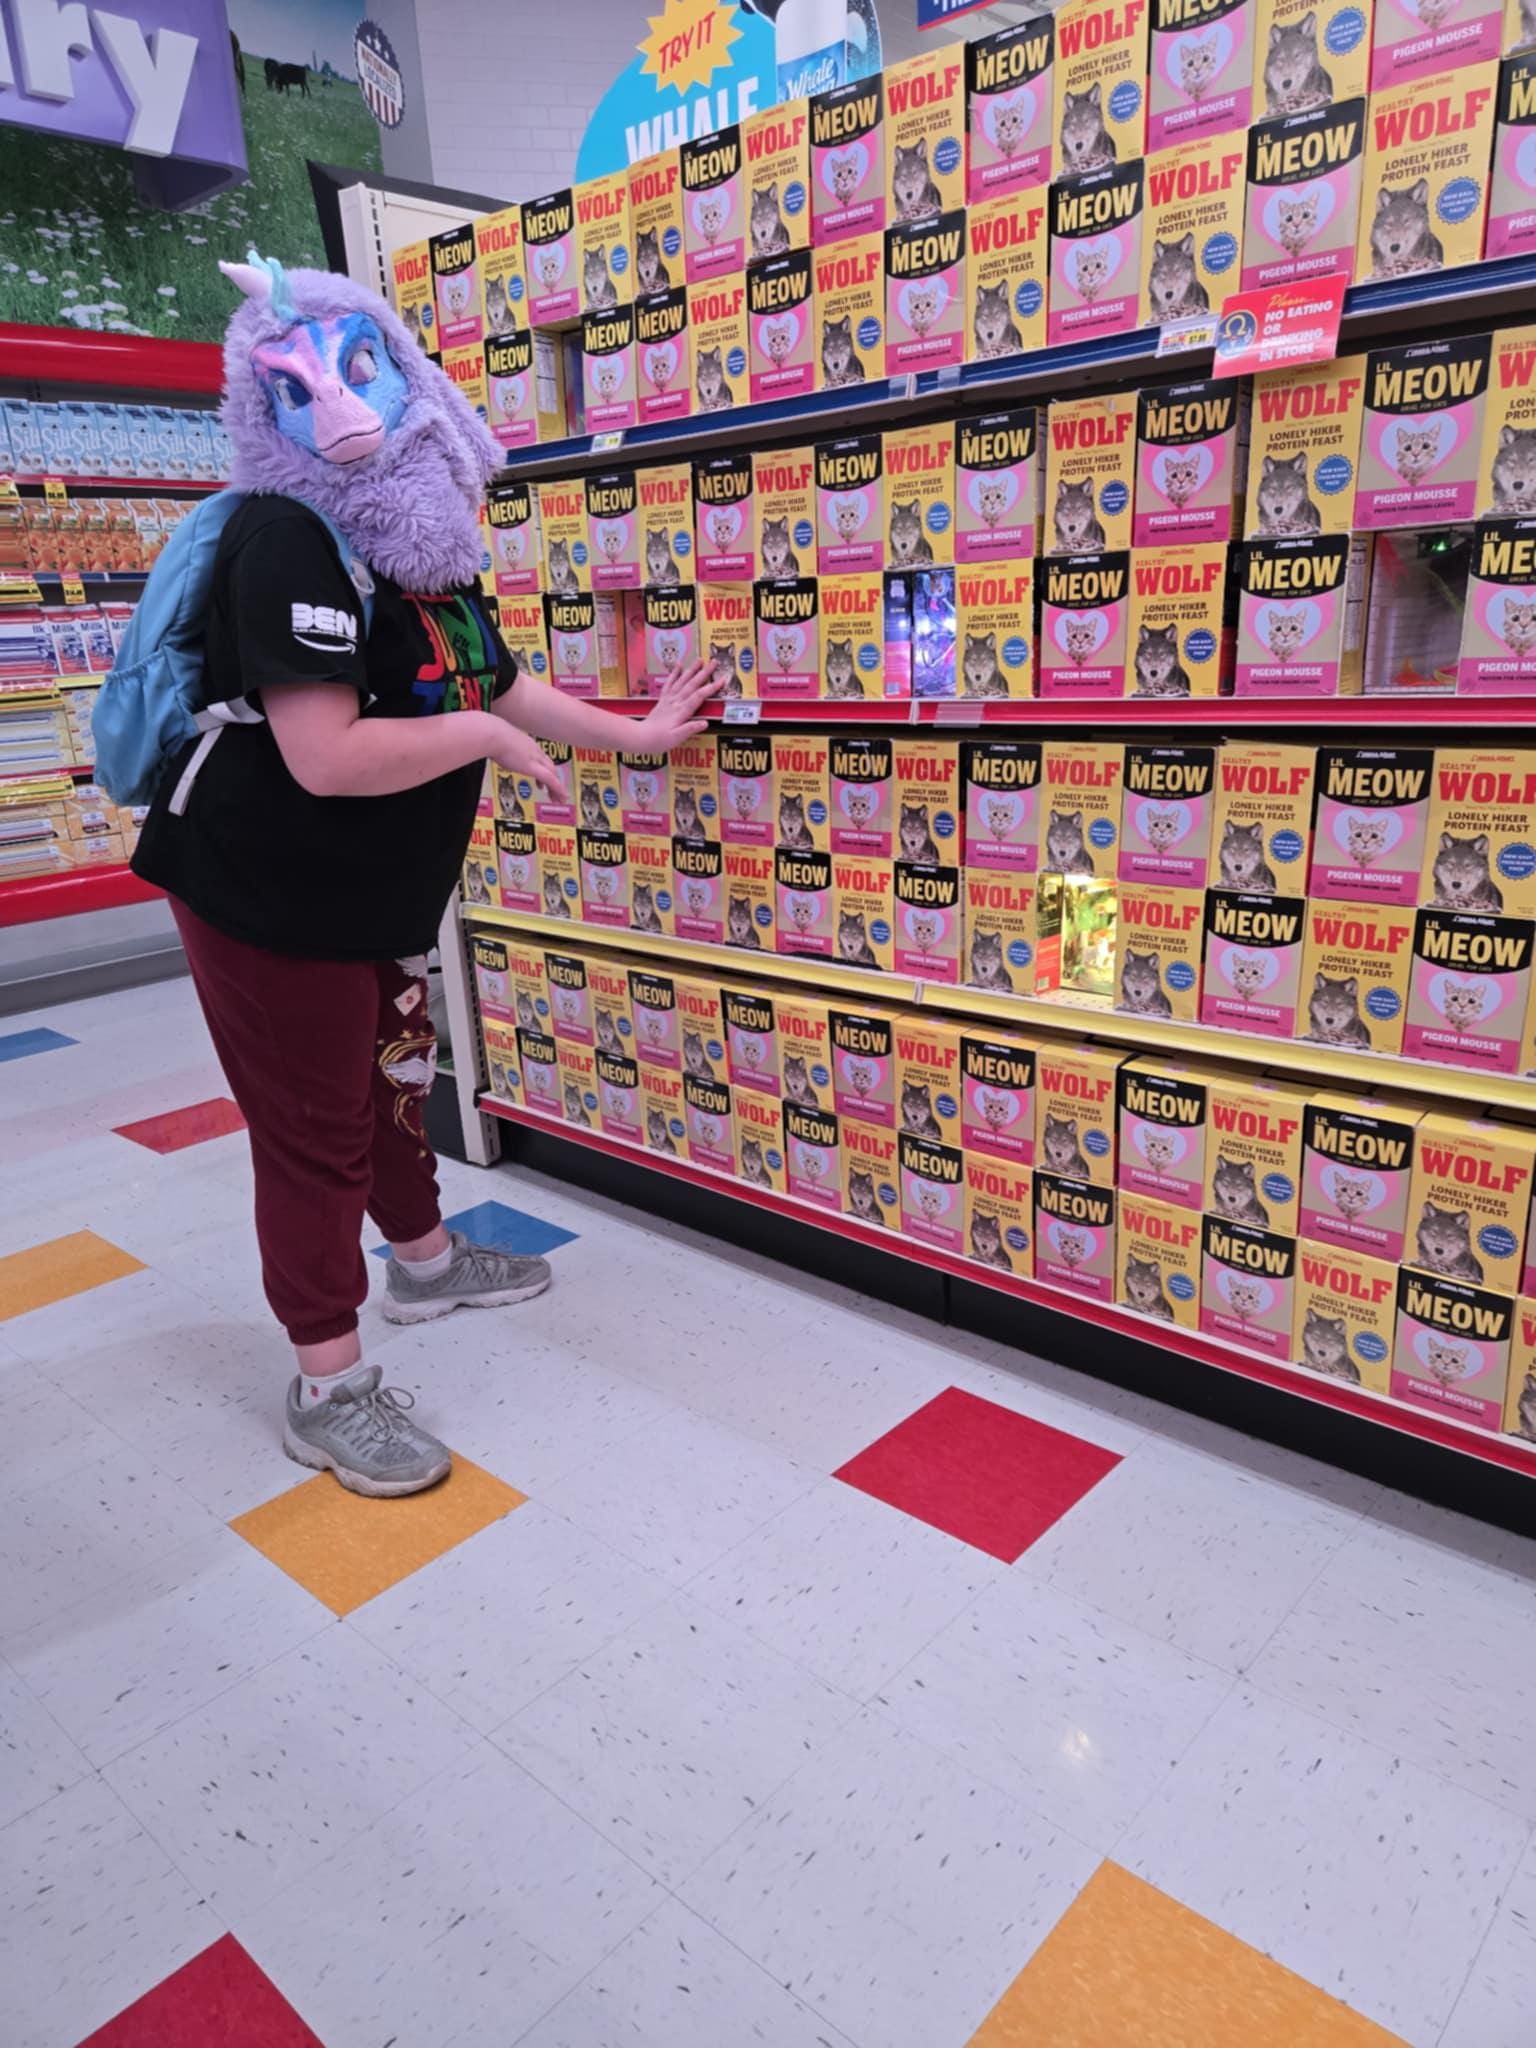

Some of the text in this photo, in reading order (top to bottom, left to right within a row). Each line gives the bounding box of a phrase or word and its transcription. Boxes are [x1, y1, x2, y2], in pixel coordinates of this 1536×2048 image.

[658, 10, 716, 74] TRY IT
[1060, 0, 1144, 59] WOLF
[1393, 22, 1483, 60] PIGEON MOUSSE
[976, 35, 1048, 89] MEOW
[1066, 60, 1132, 88] PROTEIN FEAST
[1068, 50, 1130, 77] LONELY HIKER
[888, 66, 961, 116] WOLF
[814, 95, 877, 143] MEOW
[1375, 87, 1491, 151] WOLF
[747, 115, 806, 162] WOLF
[1256, 123, 1356, 181] MEOW
[1258, 134, 1271, 145] LIL
[685, 145, 737, 187] MEOW
[1381, 155, 1471, 183] PROTEIN FEAST
[1385, 143, 1468, 171] LONELY HIKER
[629, 166, 678, 206] WOLF
[1149, 153, 1242, 206] WOLF
[577, 187, 626, 224] WOLF
[1058, 183, 1138, 234] MEOW
[526, 205, 570, 241] MEOW
[971, 208, 1044, 255] WOLF
[478, 222, 519, 256] WOLF
[892, 230, 960, 274] MEOW
[394, 254, 428, 285] WOLF
[435, 240, 472, 273] MEOW
[816, 252, 880, 293] WOLF
[752, 271, 807, 310] MEOW
[691, 288, 744, 325] WOLF
[1265, 300, 1333, 322] NO EATING
[585, 320, 630, 351] MEOW
[638, 305, 683, 340] MEOW
[1263, 323, 1281, 335] OR
[1261, 328, 1323, 347] DRINKING
[489, 344, 529, 373] MEOW
[1259, 342, 1314, 362] IN STORE
[445, 356, 483, 383] WOLF
[1377, 362, 1392, 373] LIL
[1373, 359, 1482, 407] MEOW
[1259, 378, 1360, 423] WOLF
[1052, 412, 1133, 450] WOLF
[1146, 398, 1231, 439] MEOW
[1269, 424, 1341, 441] LONELY HIKER
[961, 428, 1030, 465] MEOW
[1266, 435, 1344, 451] PROTEIN FEAST
[819, 452, 878, 485] MEOW
[885, 441, 952, 476] WOLF
[640, 479, 689, 505] WOLF
[700, 472, 748, 499] MEOW
[756, 464, 812, 494] WOLF
[541, 494, 584, 518] WOLF
[589, 487, 633, 512] MEOW
[1374, 488, 1458, 504] PIGEON MOUSSE
[489, 498, 527, 523] MEOW
[1251, 552, 1264, 561] LIL
[1049, 570, 1123, 601] MEOW
[1135, 563, 1222, 596] WOLF
[1248, 555, 1341, 590] MEOW
[761, 594, 813, 618] MEOW
[821, 589, 880, 614] WOLF
[960, 577, 1029, 607] WOLF
[291, 603, 357, 637] BEN
[501, 607, 541, 628] WOLF
[552, 605, 592, 626] MEOW
[648, 600, 693, 622] MEOW
[704, 596, 752, 620] WOLF
[1251, 667, 1323, 677] PIGEON MOUSSE
[576, 747, 613, 764] WOLF
[623, 752, 663, 766] MEOW
[670, 748, 715, 769] WOLF
[722, 750, 768, 772] MEOW
[775, 750, 826, 773] WOLF
[834, 753, 887, 776] MEOW
[1331, 758, 1344, 767] LIL
[972, 759, 1036, 784] MEOW
[1047, 759, 1120, 787] WOLF
[1130, 761, 1207, 792] MEOW
[1222, 764, 1310, 795] WOLF
[1327, 768, 1425, 798] MEOW
[1444, 821, 1530, 832] PROTEIN FEAST
[1448, 811, 1528, 823] LONELY HIKER
[499, 829, 533, 851] MEOW
[538, 836, 575, 856] WOLF
[582, 839, 623, 862] MEOW
[628, 845, 670, 867] WOLF
[676, 850, 718, 873] MEOW
[725, 855, 772, 879] WOLF
[779, 862, 827, 887] MEOW
[835, 867, 891, 893] WOLF
[899, 877, 954, 903] MEOW
[968, 883, 1034, 911] WOLF
[1122, 899, 1200, 931] WOLF
[1215, 909, 1297, 942] MEOW
[1313, 917, 1410, 954] WOLF
[1423, 928, 1526, 968] MEOW
[475, 948, 506, 969] MEOW
[510, 958, 544, 978] WOLF
[549, 964, 583, 987] MEOW
[589, 974, 626, 996] WOLF
[633, 984, 673, 1007] MEOW
[677, 992, 719, 1018] WOLF
[728, 1003, 771, 1029] MEOW
[778, 1014, 826, 1040] WOLF
[485, 1030, 514, 1050] WOLF
[522, 1039, 554, 1062] MEOW
[835, 1025, 887, 1053] MEOW
[1422, 1031, 1458, 1044] PIGEON
[1460, 1037, 1501, 1051] MOUSSE
[559, 1051, 593, 1073] WOLF
[897, 1038, 957, 1069] WOLF
[600, 1062, 636, 1086] MEOW
[967, 1055, 1030, 1086] MEOW
[642, 1072, 681, 1098] WOLF
[1041, 1068, 1112, 1102] WOLF
[687, 1086, 728, 1113] MEOW
[736, 1098, 781, 1128] WOLF
[1126, 1086, 1200, 1124] MEOW
[788, 1115, 835, 1144] MEOW
[1213, 1104, 1298, 1144] WOLF
[843, 1128, 896, 1161] WOLF
[1313, 1125, 1406, 1168] MEOW
[903, 1148, 959, 1181] MEOW
[1421, 1147, 1528, 1194] WOLF
[967, 1167, 1030, 1202] WOLF
[1041, 1187, 1109, 1223] MEOW
[1122, 1208, 1198, 1248] WOLF
[1209, 1233, 1288, 1276] MEOW
[1302, 1257, 1393, 1304] WOLF
[1407, 1289, 1506, 1338] MEOW
